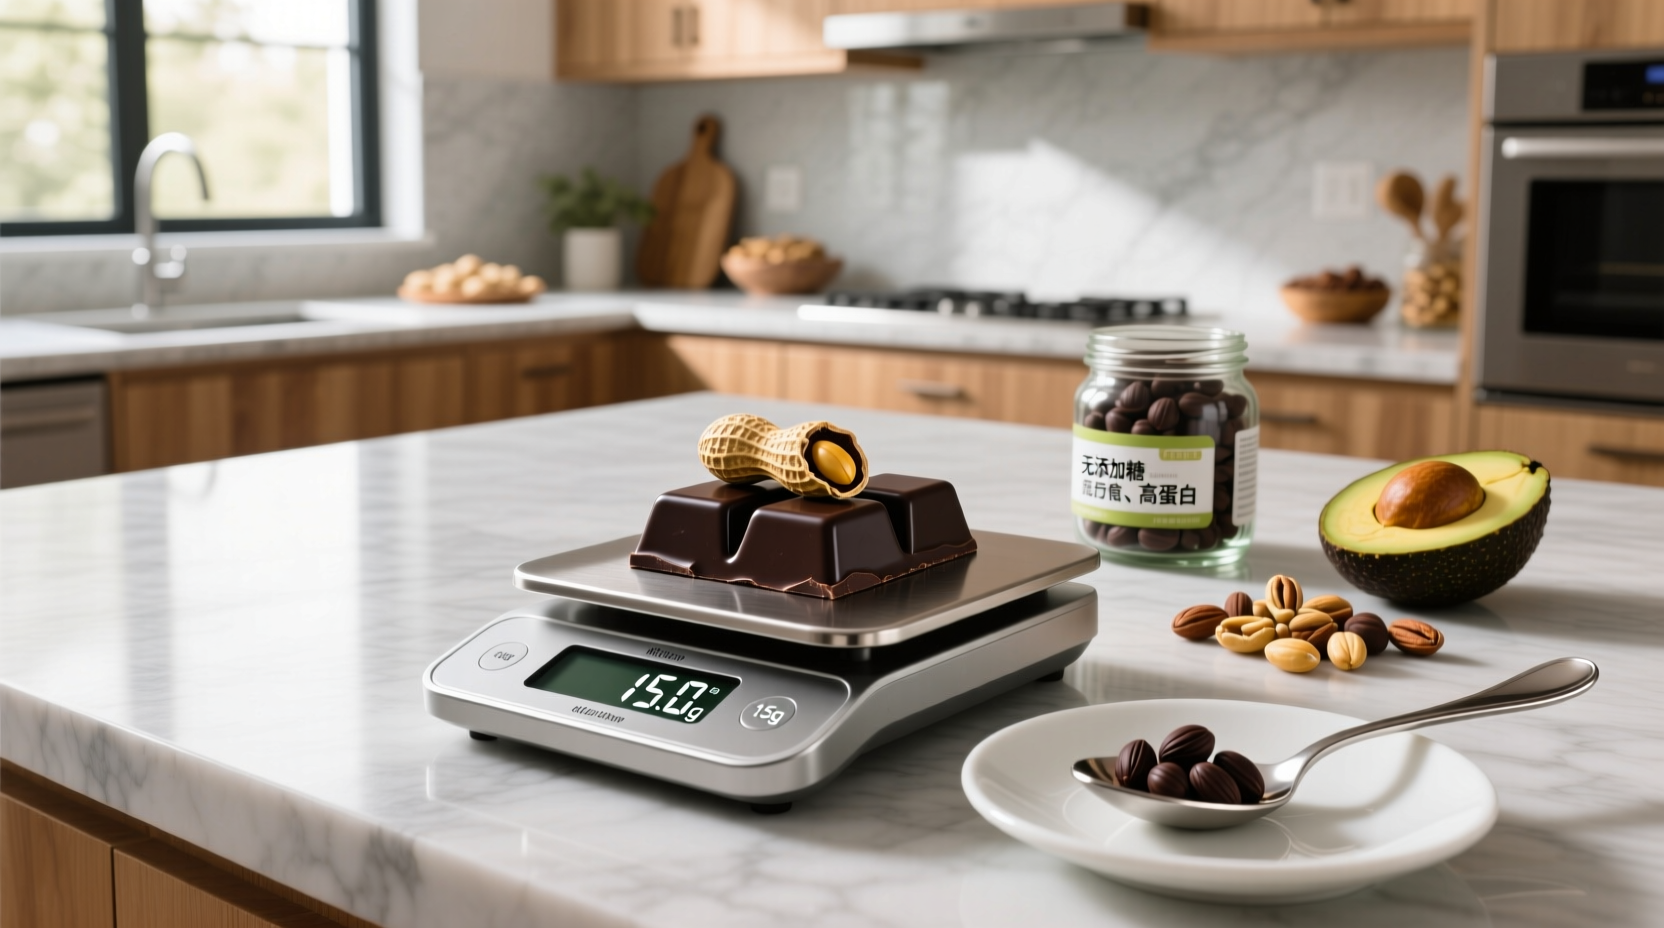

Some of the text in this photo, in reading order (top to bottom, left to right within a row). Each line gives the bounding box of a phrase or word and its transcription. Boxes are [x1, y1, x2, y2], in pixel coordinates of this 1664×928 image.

[1081, 454, 1145, 482] 无添加糖
[752, 703, 785, 725] 15g
